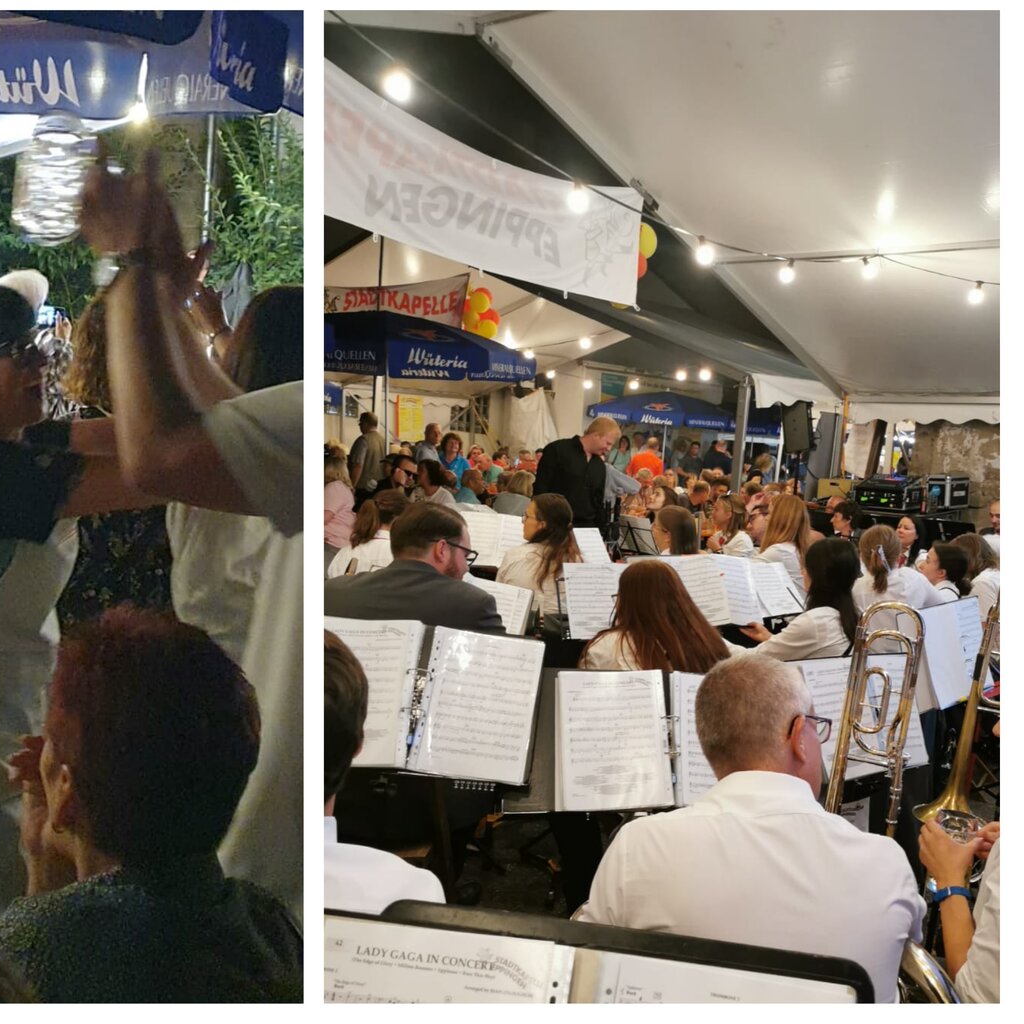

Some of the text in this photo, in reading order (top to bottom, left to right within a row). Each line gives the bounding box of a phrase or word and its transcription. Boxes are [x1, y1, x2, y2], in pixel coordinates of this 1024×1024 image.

[343, 288, 458, 316] STADTKAPELLE
[407, 347, 468, 369] Wüteria
[356, 945, 388, 958] LADY
[390, 949, 424, 963] GAGA
[426, 954, 440, 964] IN
[441, 955, 494, 971] CONCERT
